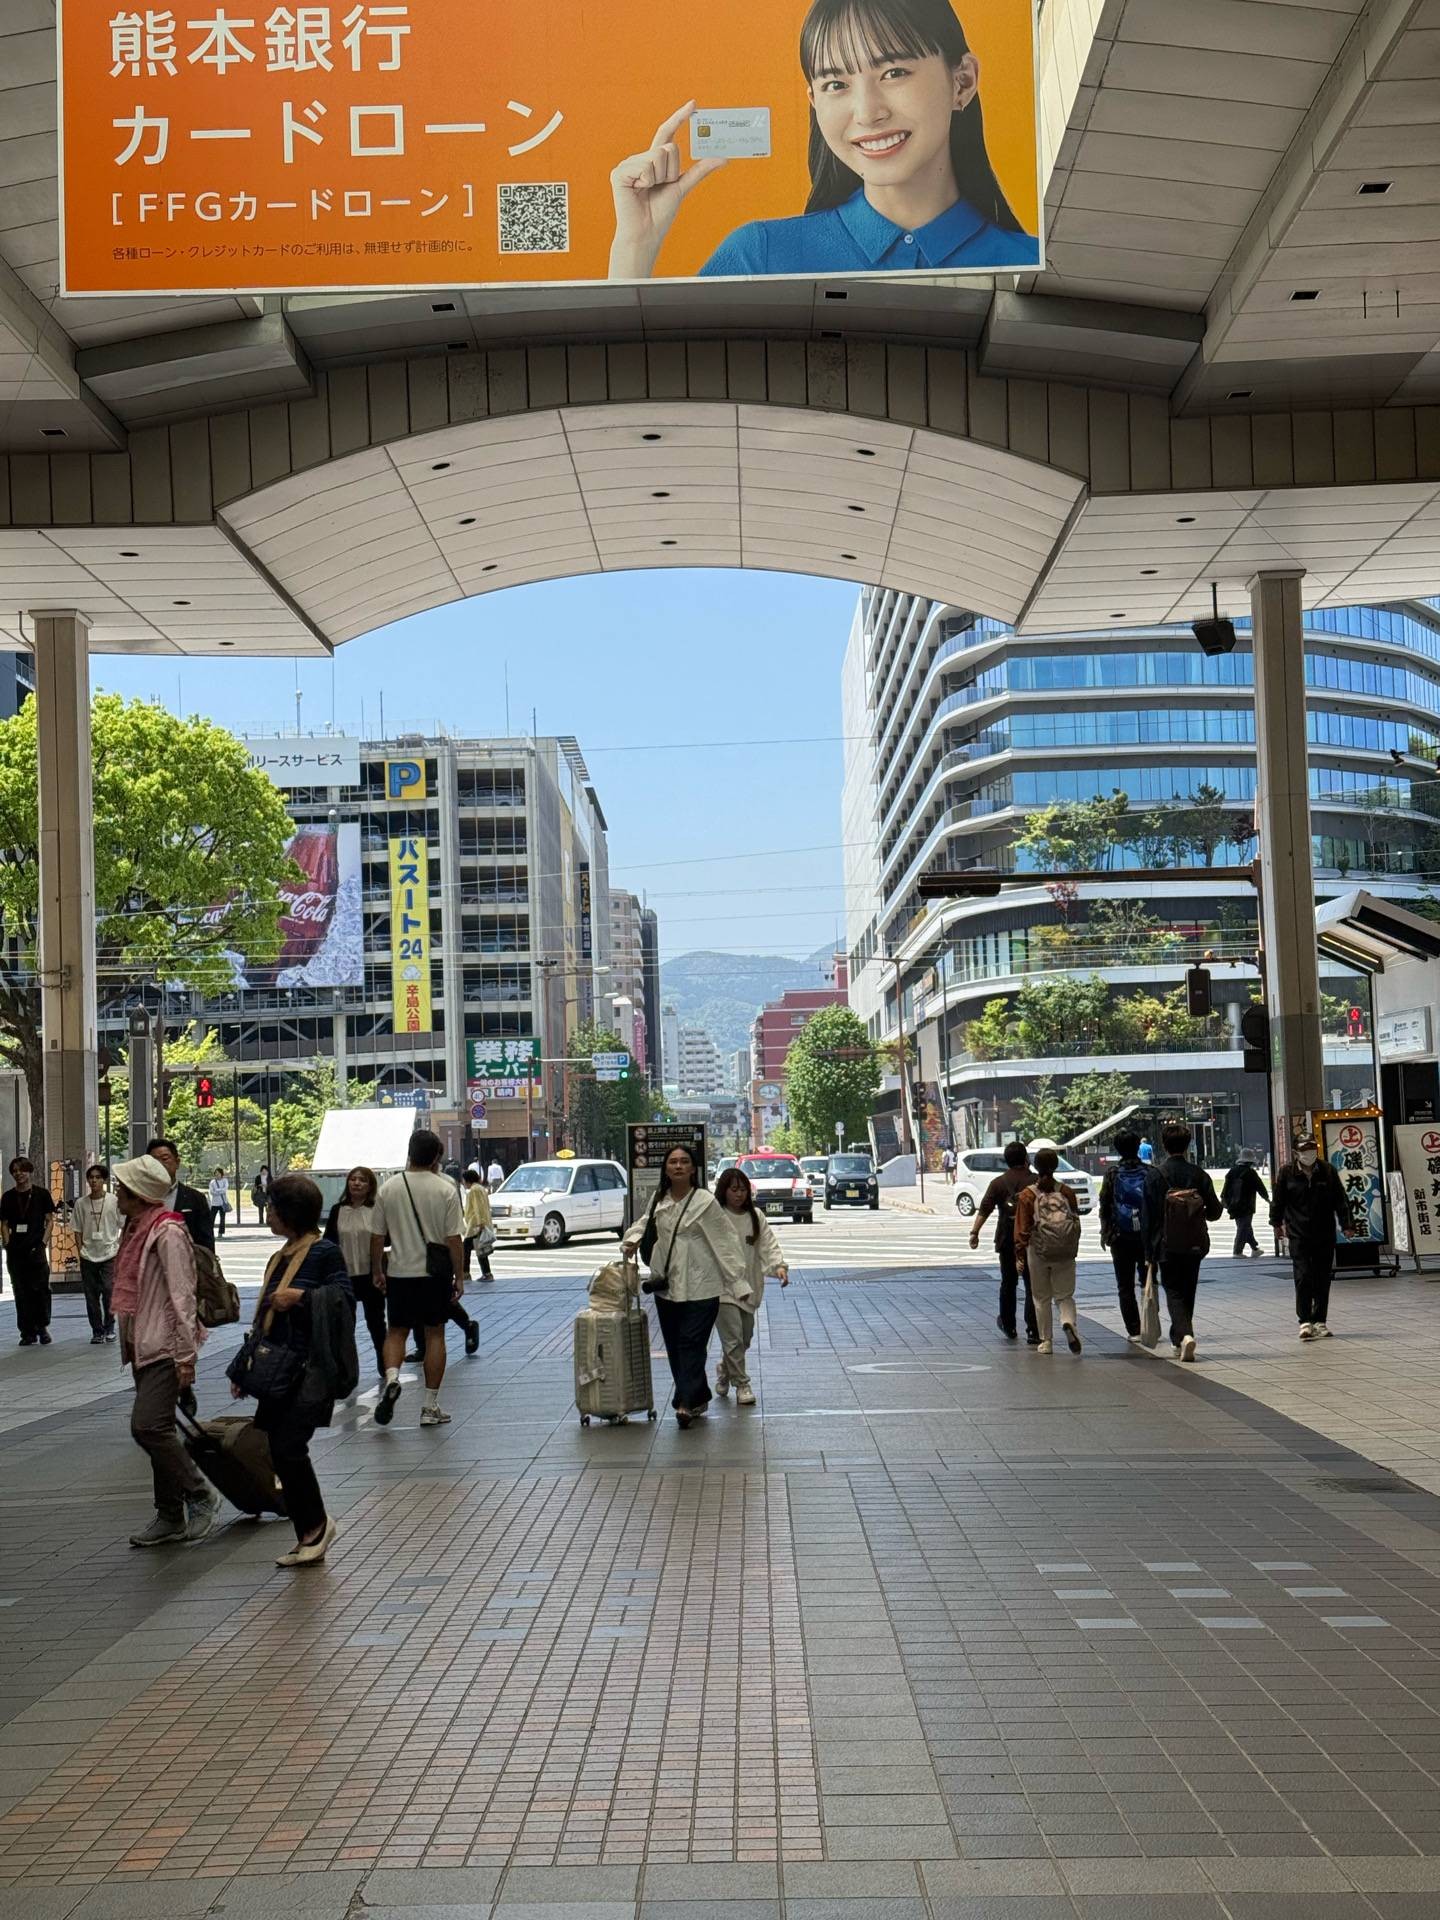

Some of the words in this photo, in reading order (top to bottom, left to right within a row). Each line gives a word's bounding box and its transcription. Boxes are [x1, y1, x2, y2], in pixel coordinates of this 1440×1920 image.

[109, 4, 411, 77] 熊本銀行
[112, 100, 564, 166] カードローン
[388, 761, 422, 798] P
[406, 984, 421, 1032] 辛島公園
[473, 1040, 534, 1063] 業務
[474, 1062, 535, 1078] スーパー
[1343, 1151, 1369, 1238] 磯丸水産
[1413, 1188, 1432, 1236] 新市街店
